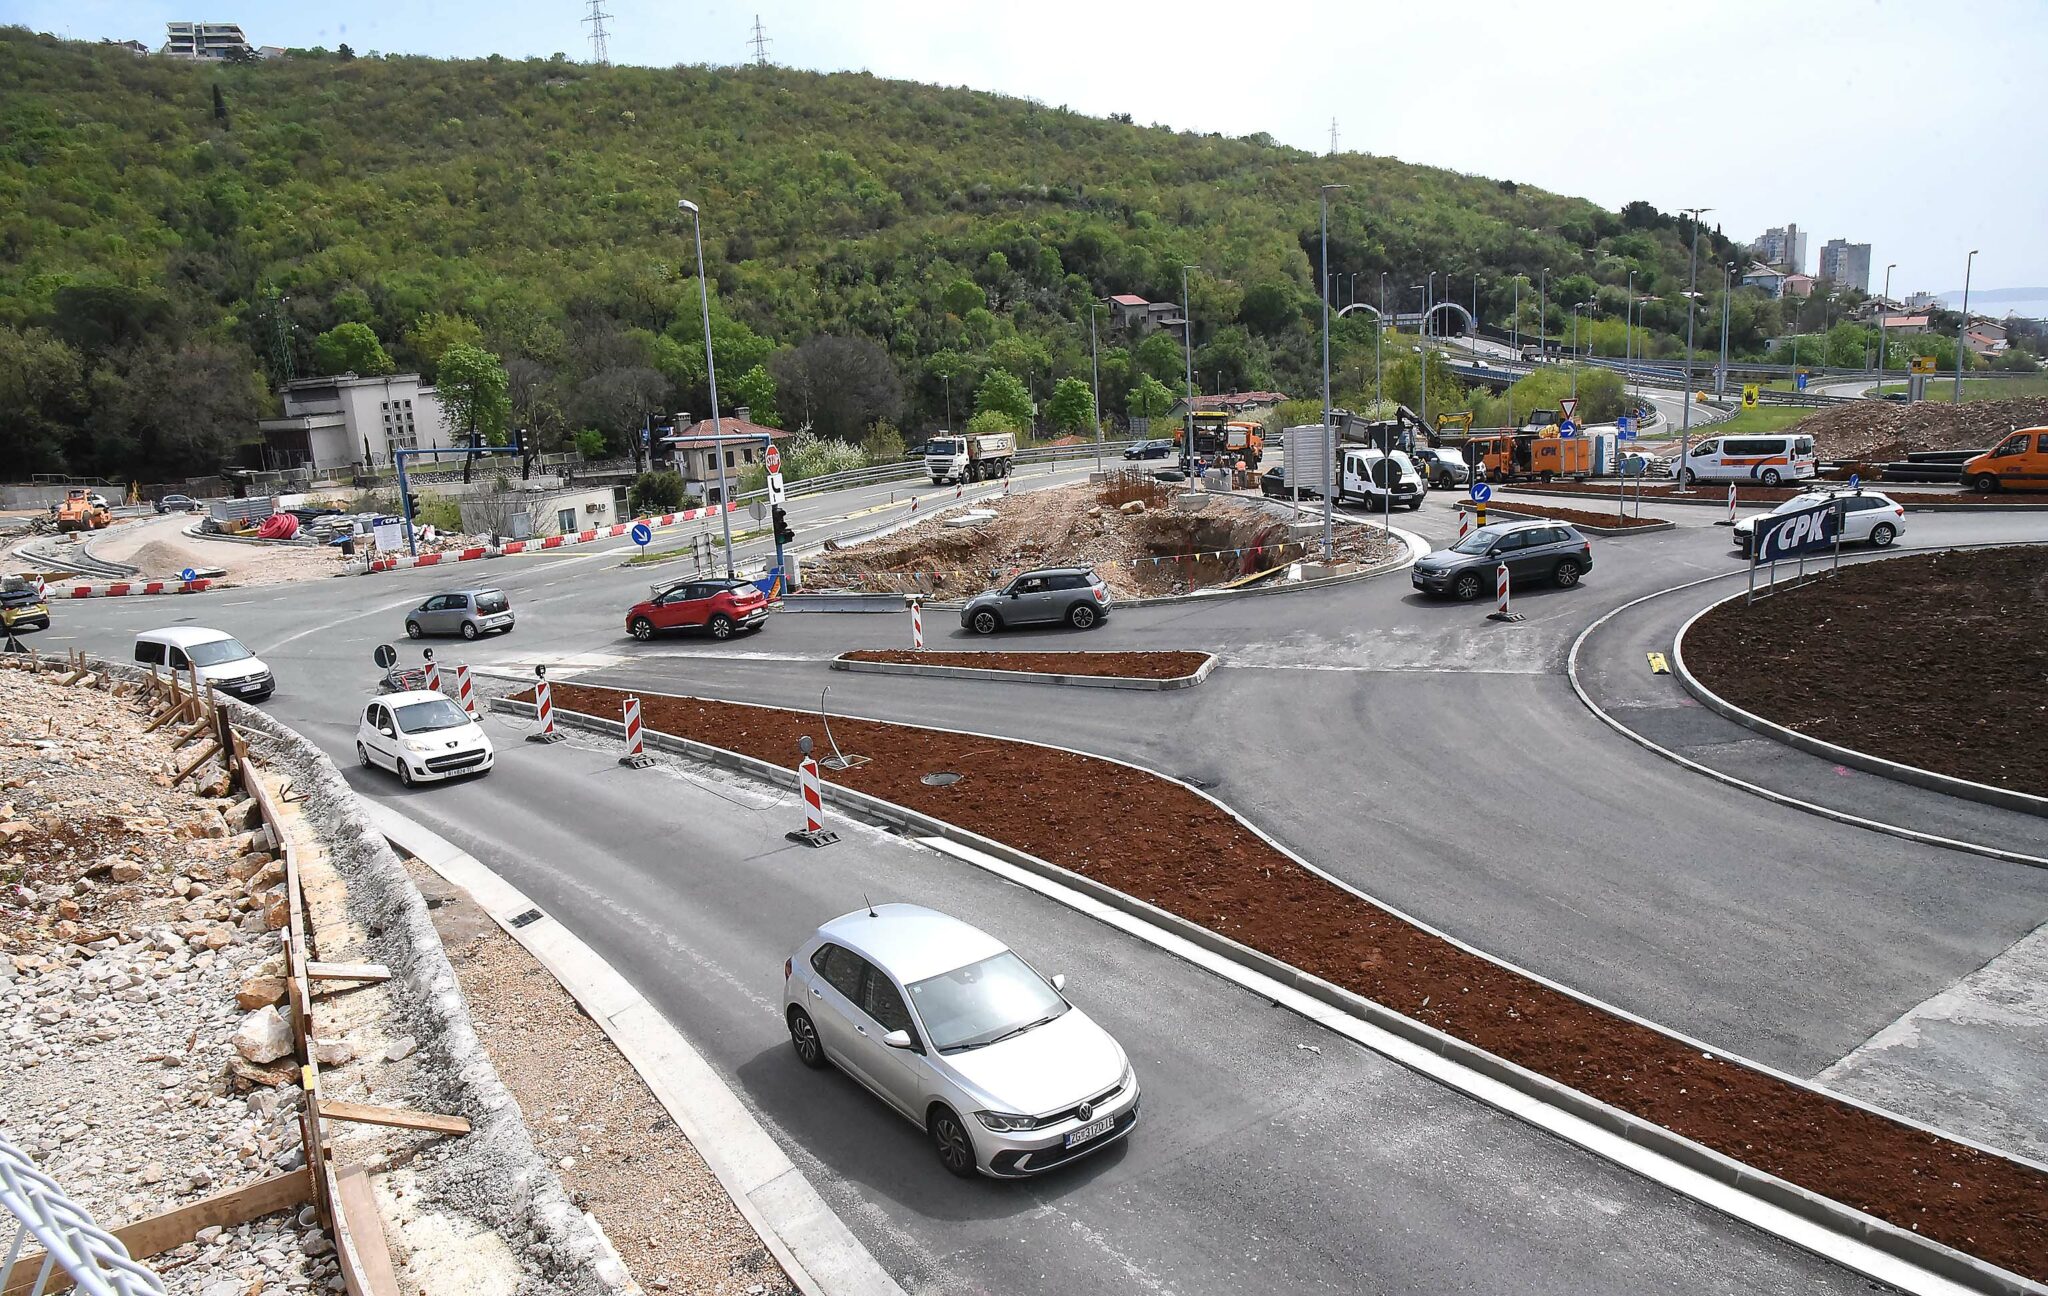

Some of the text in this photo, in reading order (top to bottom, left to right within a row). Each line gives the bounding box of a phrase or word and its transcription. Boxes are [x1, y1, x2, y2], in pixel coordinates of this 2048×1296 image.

[766, 454, 780, 466] STOP
[1778, 509, 1828, 550] CPK
[1072, 1131, 1081, 1144] ZG
